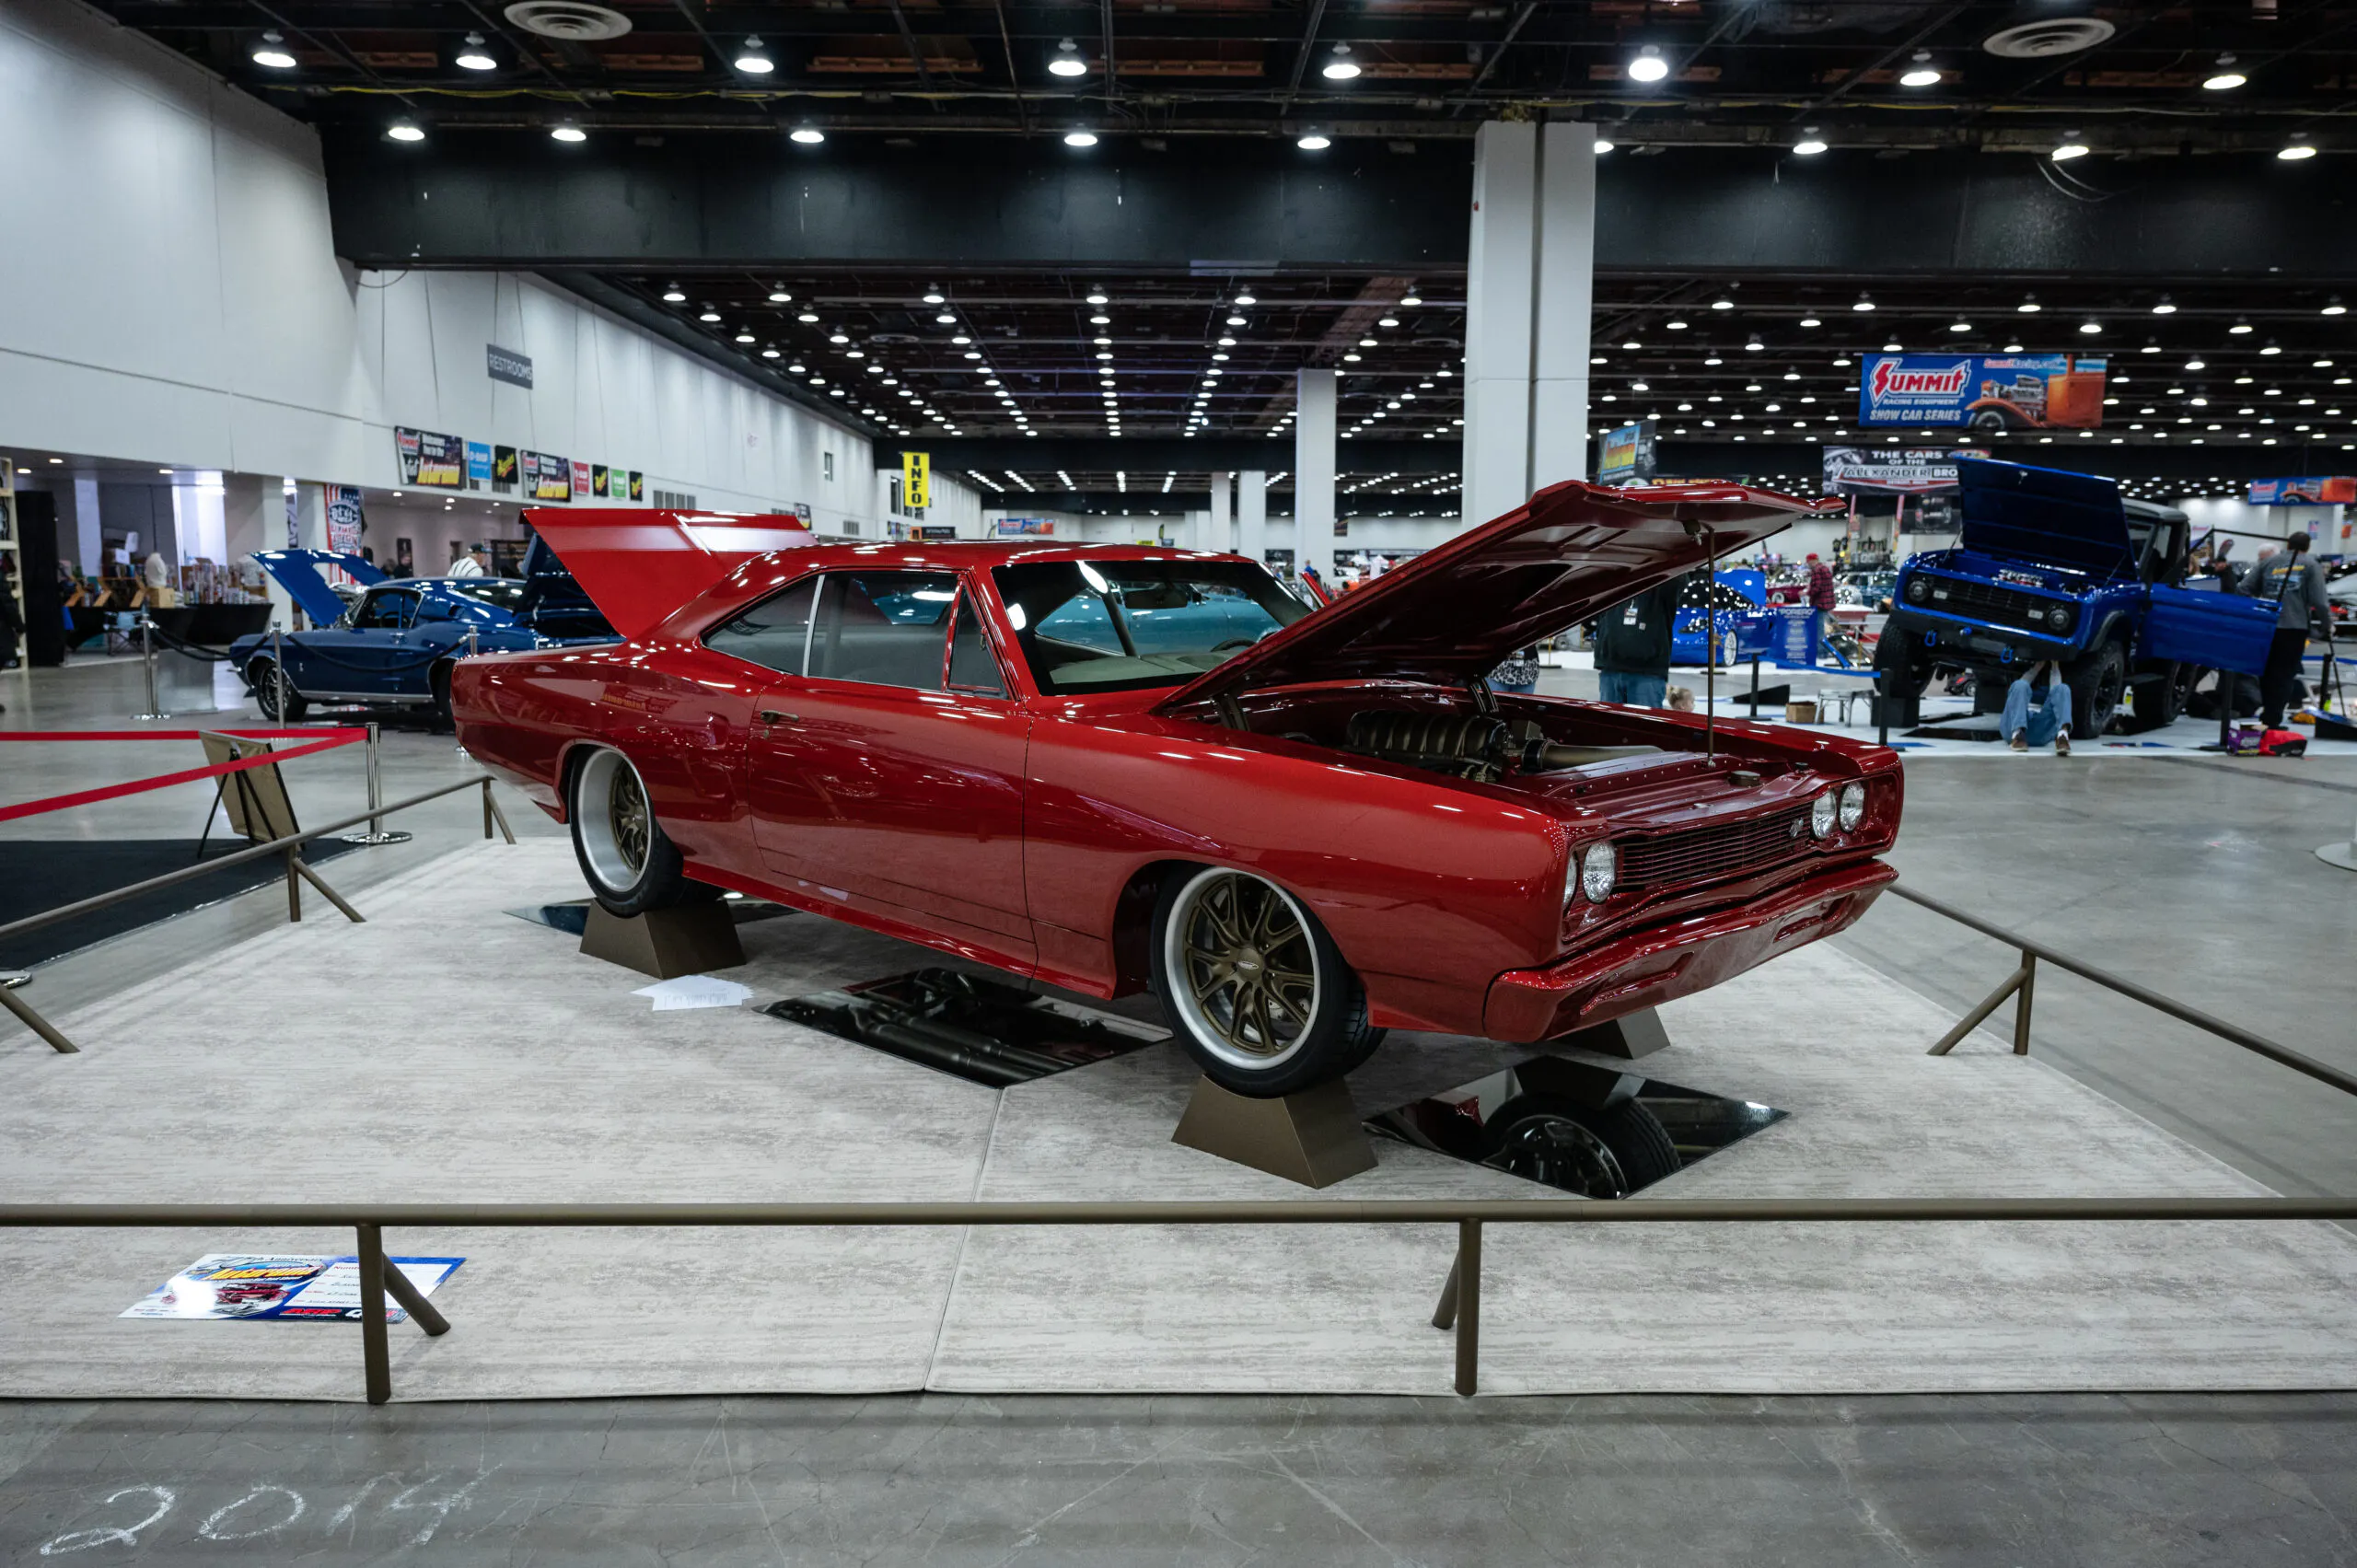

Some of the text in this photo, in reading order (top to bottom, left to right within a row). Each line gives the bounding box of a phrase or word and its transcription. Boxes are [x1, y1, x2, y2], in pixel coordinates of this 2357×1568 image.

[489, 353, 532, 380] RESTROOMS
[1873, 361, 1966, 401] SUMMIT
[1869, 409, 1961, 421] SHOW CAR SERIES
[1871, 450, 1944, 459] THE CARS
[911, 455, 922, 505] INFO
[1844, 466, 1958, 479] ALEXANDER BRO
